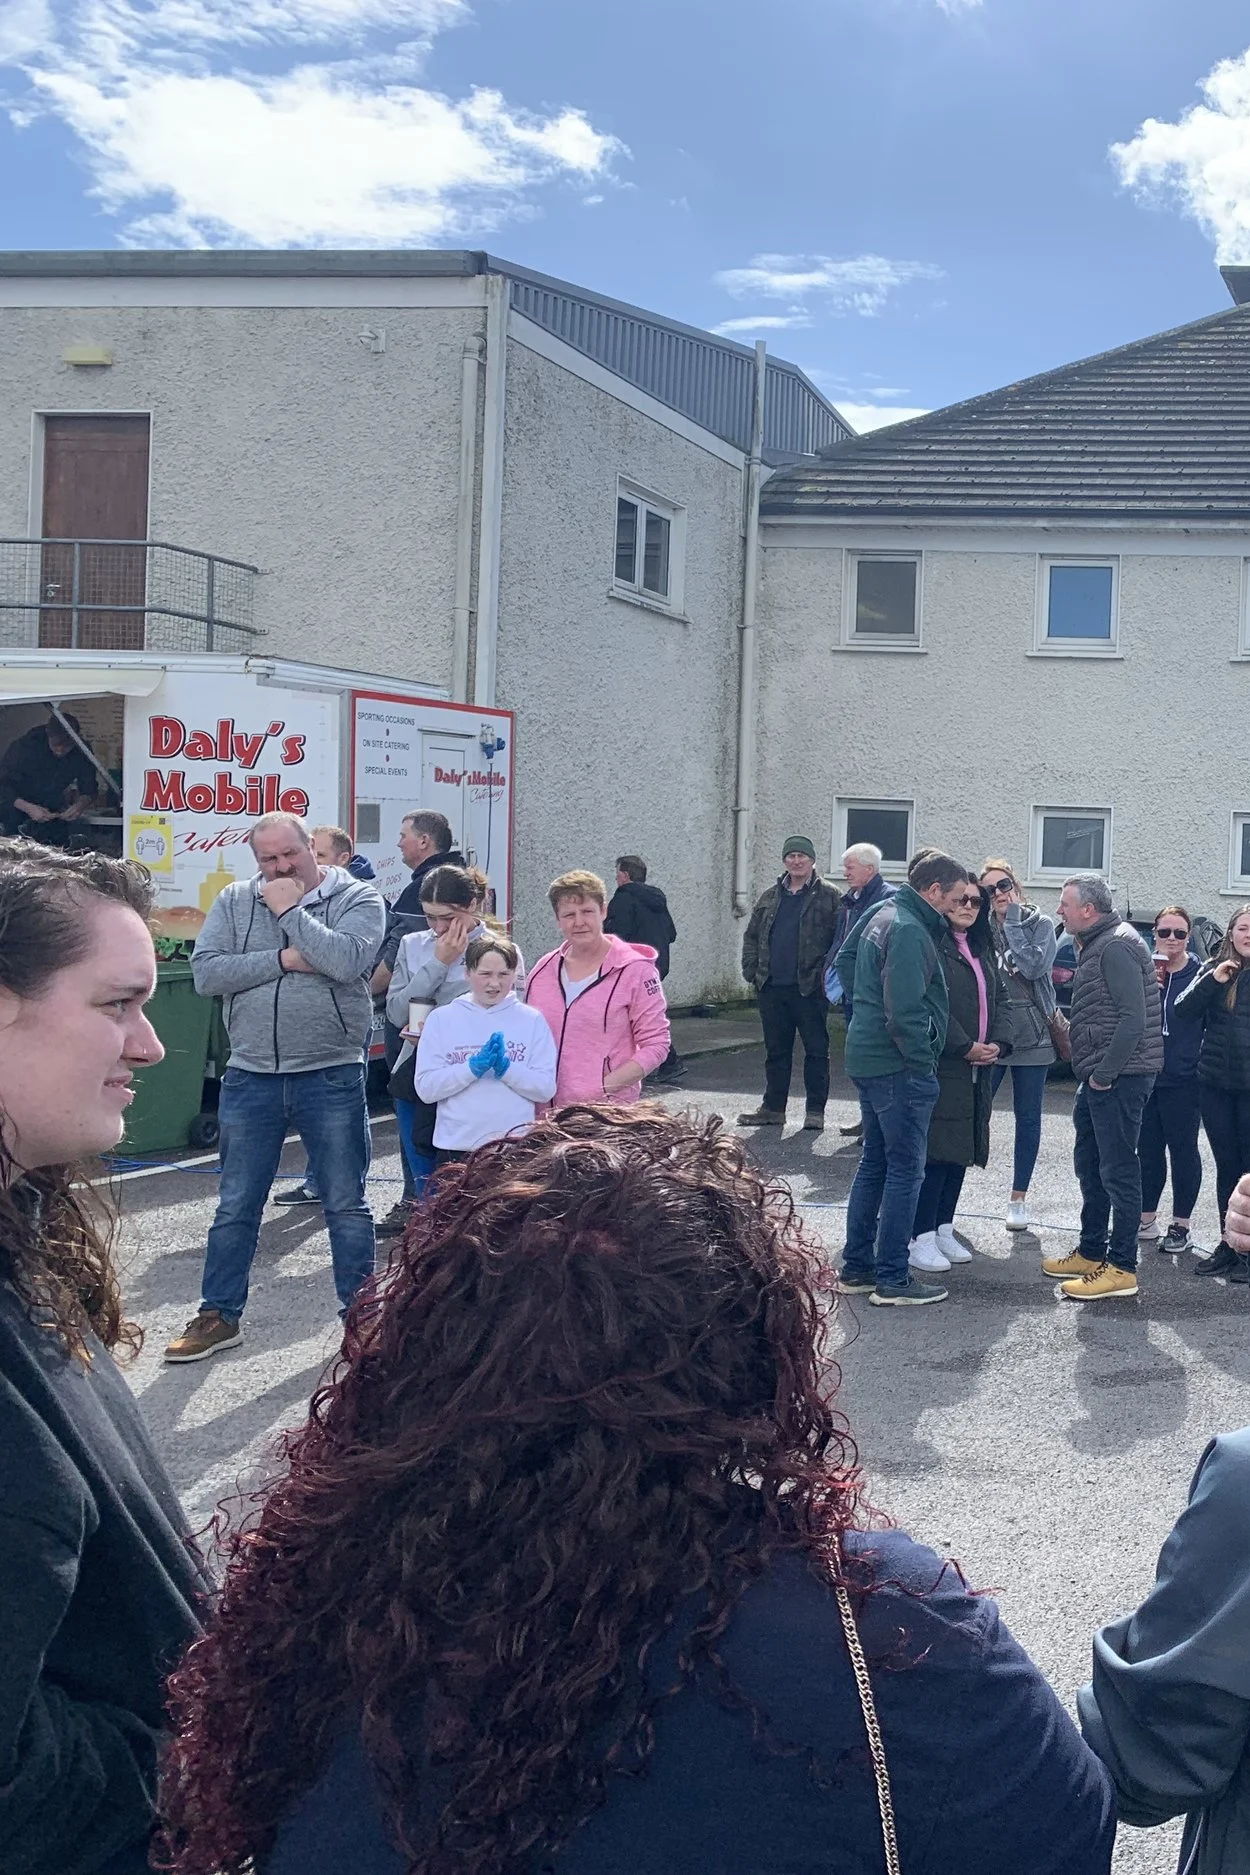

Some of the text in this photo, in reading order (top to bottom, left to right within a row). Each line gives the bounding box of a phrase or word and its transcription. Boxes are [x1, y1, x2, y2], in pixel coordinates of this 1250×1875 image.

[357, 711, 415, 726] SPORTING OCCASIONS
[149, 715, 306, 769] Daly's
[362, 738, 409, 751] ON SITE CATERING
[364, 766, 408, 777] SPECIAL EVENTS
[140, 769, 309, 817] Mobile
[376, 856, 395, 870] CHIPS
